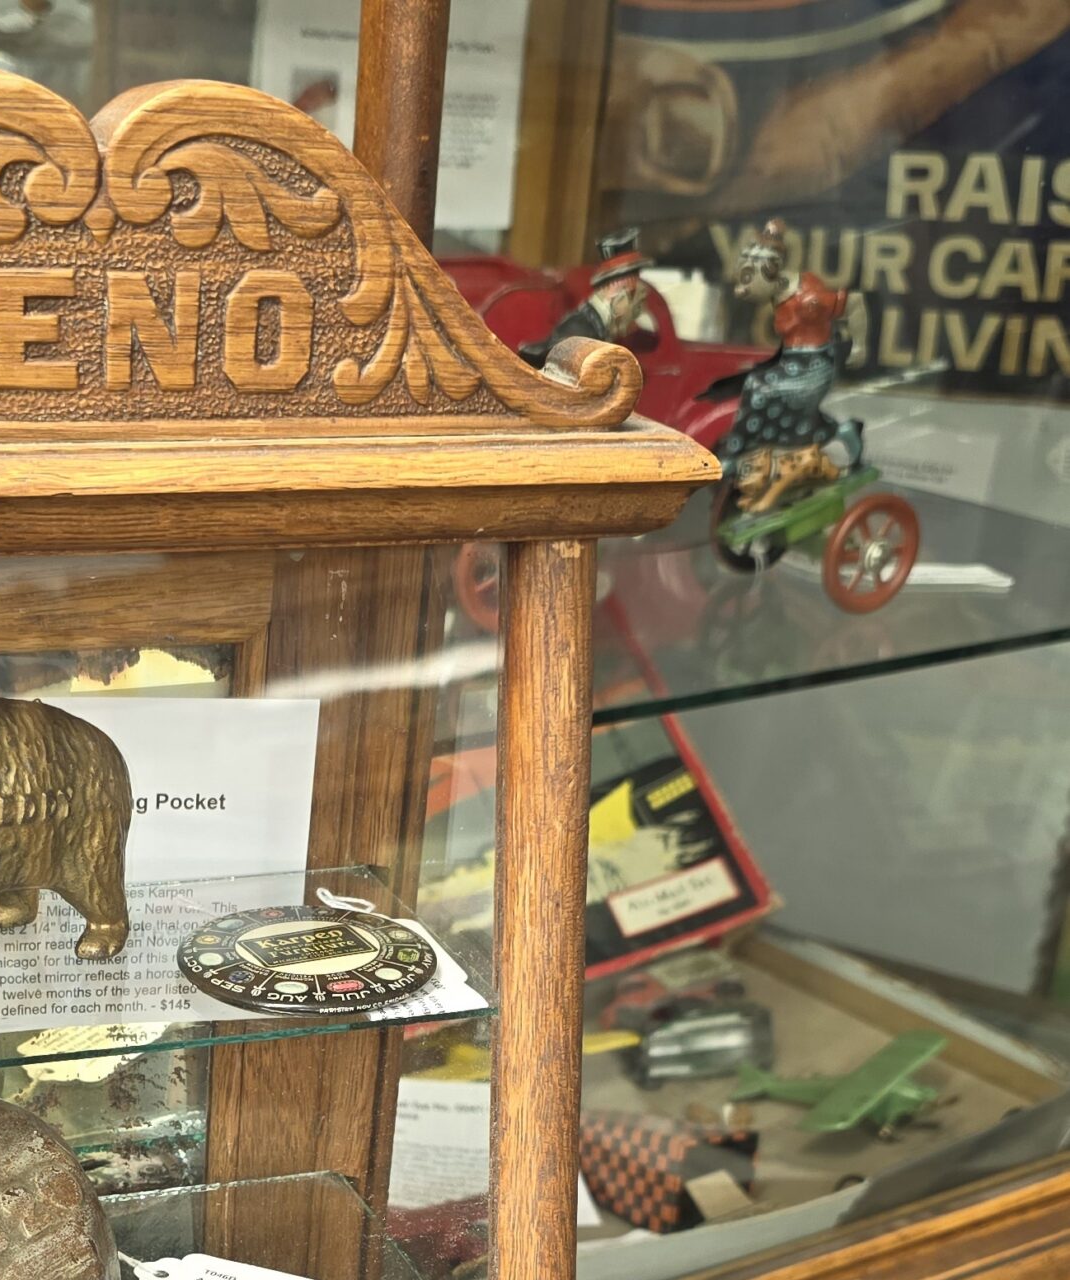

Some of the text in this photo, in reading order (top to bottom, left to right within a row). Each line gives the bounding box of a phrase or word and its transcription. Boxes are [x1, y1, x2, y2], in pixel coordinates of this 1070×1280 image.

[156, 793, 226, 810] Pocket
[149, 887, 194, 901] Karpen
[145, 903, 173, 914] New
[33, 921, 56, 935] 1/4"
[4, 939, 41, 953] mirror
[256, 928, 344, 950] Karpen
[44, 954, 60, 967] for
[130, 953, 143, 964] of
[146, 952, 169, 964] this
[183, 955, 203, 973] OCT
[0, 971, 42, 988] pocket
[44, 971, 82, 983] mirror
[85, 969, 130, 982] reflects
[134, 971, 142, 980] a
[2, 988, 42, 1001] twelve
[46, 986, 92, 999] months
[95, 985, 108, 998] of
[111, 984, 130, 997] the
[134, 984, 163, 999] year
[210, 973, 416, 1003] SEP AUG JUL JUN
[1, 1003, 48, 1017] defined
[51, 1002, 68, 1014] for
[70, 1000, 101, 1013] each
[104, 999, 147, 1013] month.
[160, 999, 192, 1012] $145
